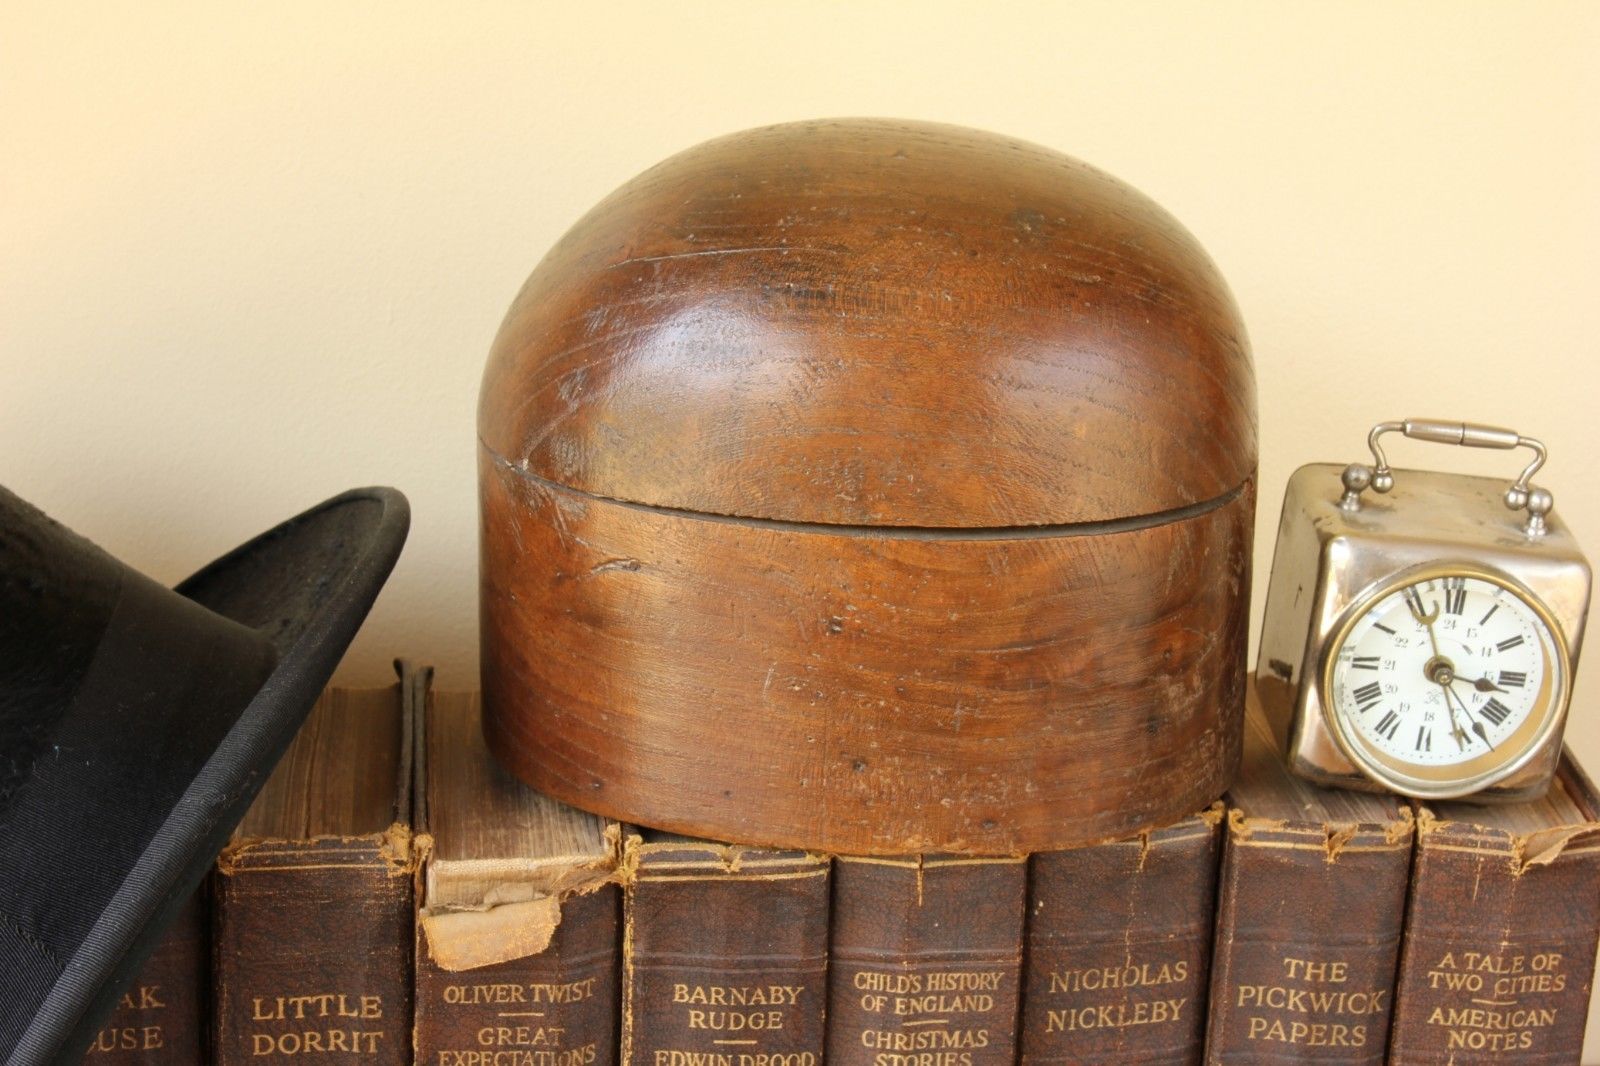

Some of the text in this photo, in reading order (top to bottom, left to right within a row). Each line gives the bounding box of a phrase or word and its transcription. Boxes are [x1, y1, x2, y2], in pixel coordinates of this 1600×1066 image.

[1283, 957, 1349, 983] THE
[1437, 952, 1562, 974] A TALE OF
[854, 971, 1005, 994] CHILD'S HISTORY
[1049, 960, 1188, 993] NICHOLAS
[1427, 971, 1567, 997] TWO CITIES
[443, 978, 597, 1004] OLIVER TWIST
[672, 983, 805, 1006] BARNABY
[1237, 985, 1386, 1015] PICKWICK
[252, 994, 384, 1020] LITTLE
[861, 994, 994, 1015] OF ENGLAND
[1045, 998, 1187, 1033] NICKLEBY
[688, 1010, 784, 1031] RUDGE
[1427, 1006, 1557, 1030] AMERICAN
[86, 1026, 164, 1055] USE
[252, 1029, 385, 1056] DORRIT
[477, 1026, 565, 1046] GREAT
[861, 1029, 989, 1051] CHRISTMAS
[1248, 1017, 1367, 1048] PAPERS
[1447, 1029, 1533, 1052] NOTES
[437, 1043, 596, 1066] EXPECTATIONS
